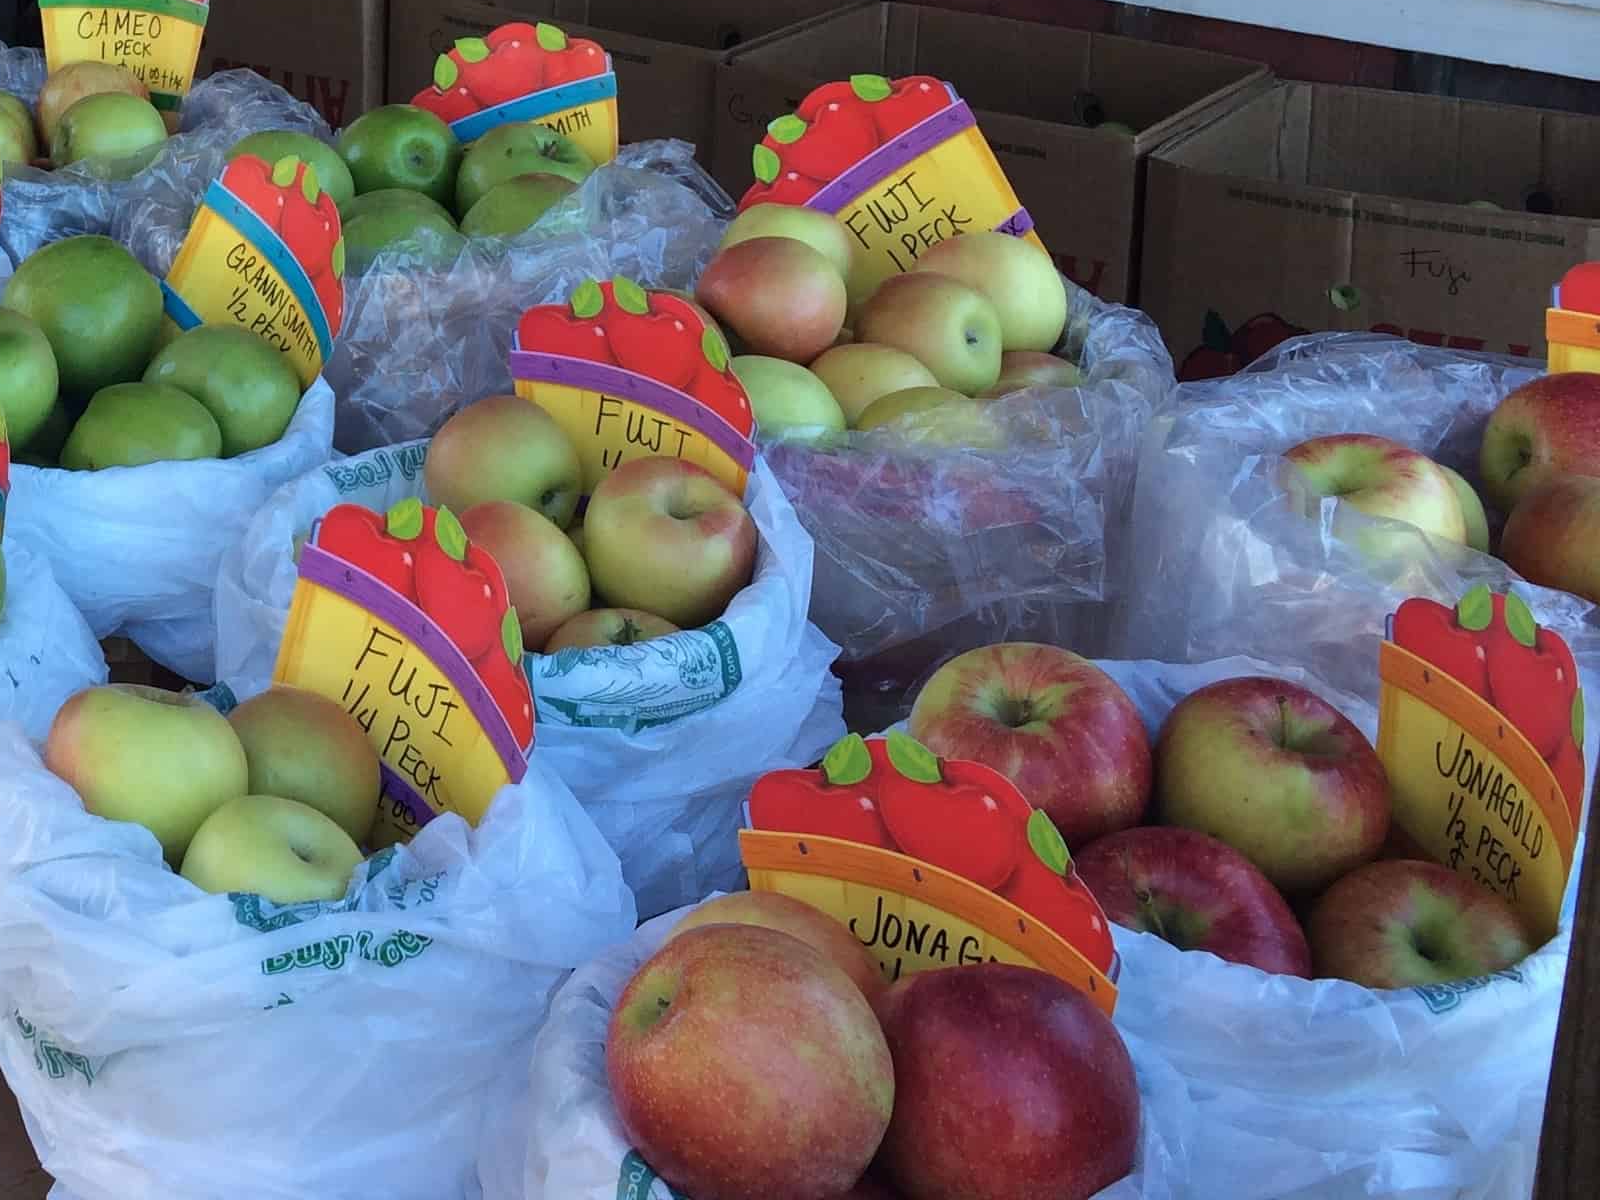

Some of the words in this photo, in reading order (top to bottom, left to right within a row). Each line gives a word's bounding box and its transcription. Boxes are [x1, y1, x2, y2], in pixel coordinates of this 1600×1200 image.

[77, 7, 162, 40] CAMEO
[114, 39, 152, 58] PECK
[844, 171, 936, 250] FUJI
[901, 203, 973, 260] PECK
[226, 242, 290, 325] GRANNY
[282, 303, 319, 362] SMITH
[355, 627, 459, 747] FUJI
[341, 678, 378, 735] 1/4
[381, 714, 445, 807] PECK
[1436, 733, 1544, 860] JONAGOLD
[1475, 824, 1522, 903] PECK
[848, 895, 998, 966] JONAG
